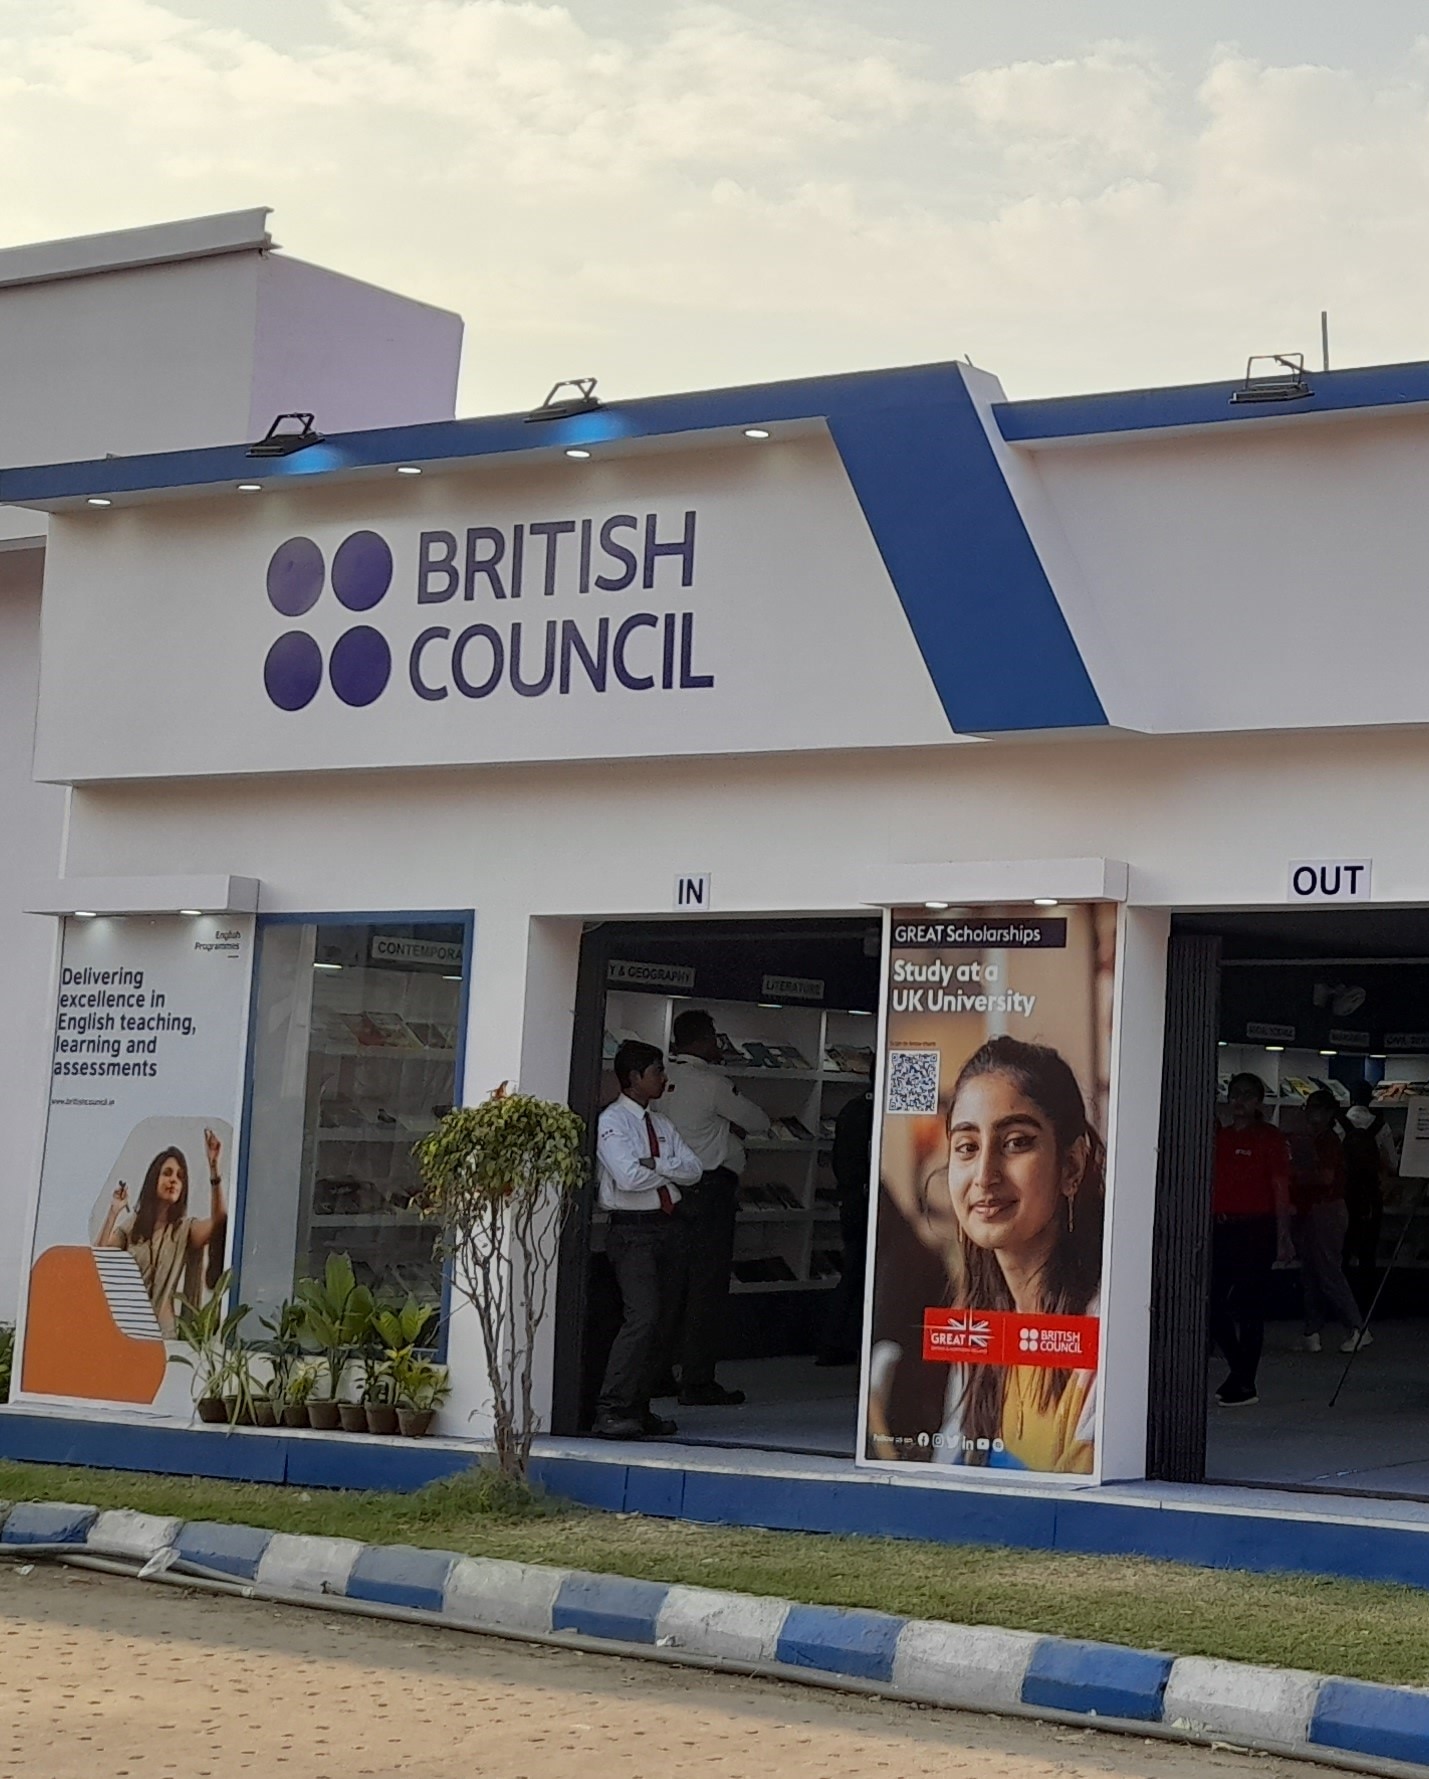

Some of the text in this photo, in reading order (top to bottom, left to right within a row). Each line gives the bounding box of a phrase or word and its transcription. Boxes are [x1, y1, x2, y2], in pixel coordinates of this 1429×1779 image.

[417, 511, 697, 604] BRITISH
[409, 612, 714, 701] COUNCIL
[678, 878, 703, 905] IN
[1293, 865, 1364, 896] OUT
[895, 925, 1041, 945] GREAT Scholarships
[62, 966, 144, 989] Delivering
[893, 960, 998, 987] Study at a
[60, 990, 165, 1008] excellence in
[892, 989, 1036, 1017] UK University
[58, 1012, 196, 1035] English teaching,
[55, 1035, 157, 1057] learning and
[53, 1060, 158, 1077] assessments
[930, 1330, 1081, 1346] GREAT BRITISH
[1040, 1341, 1083, 1353] COUNCIL
